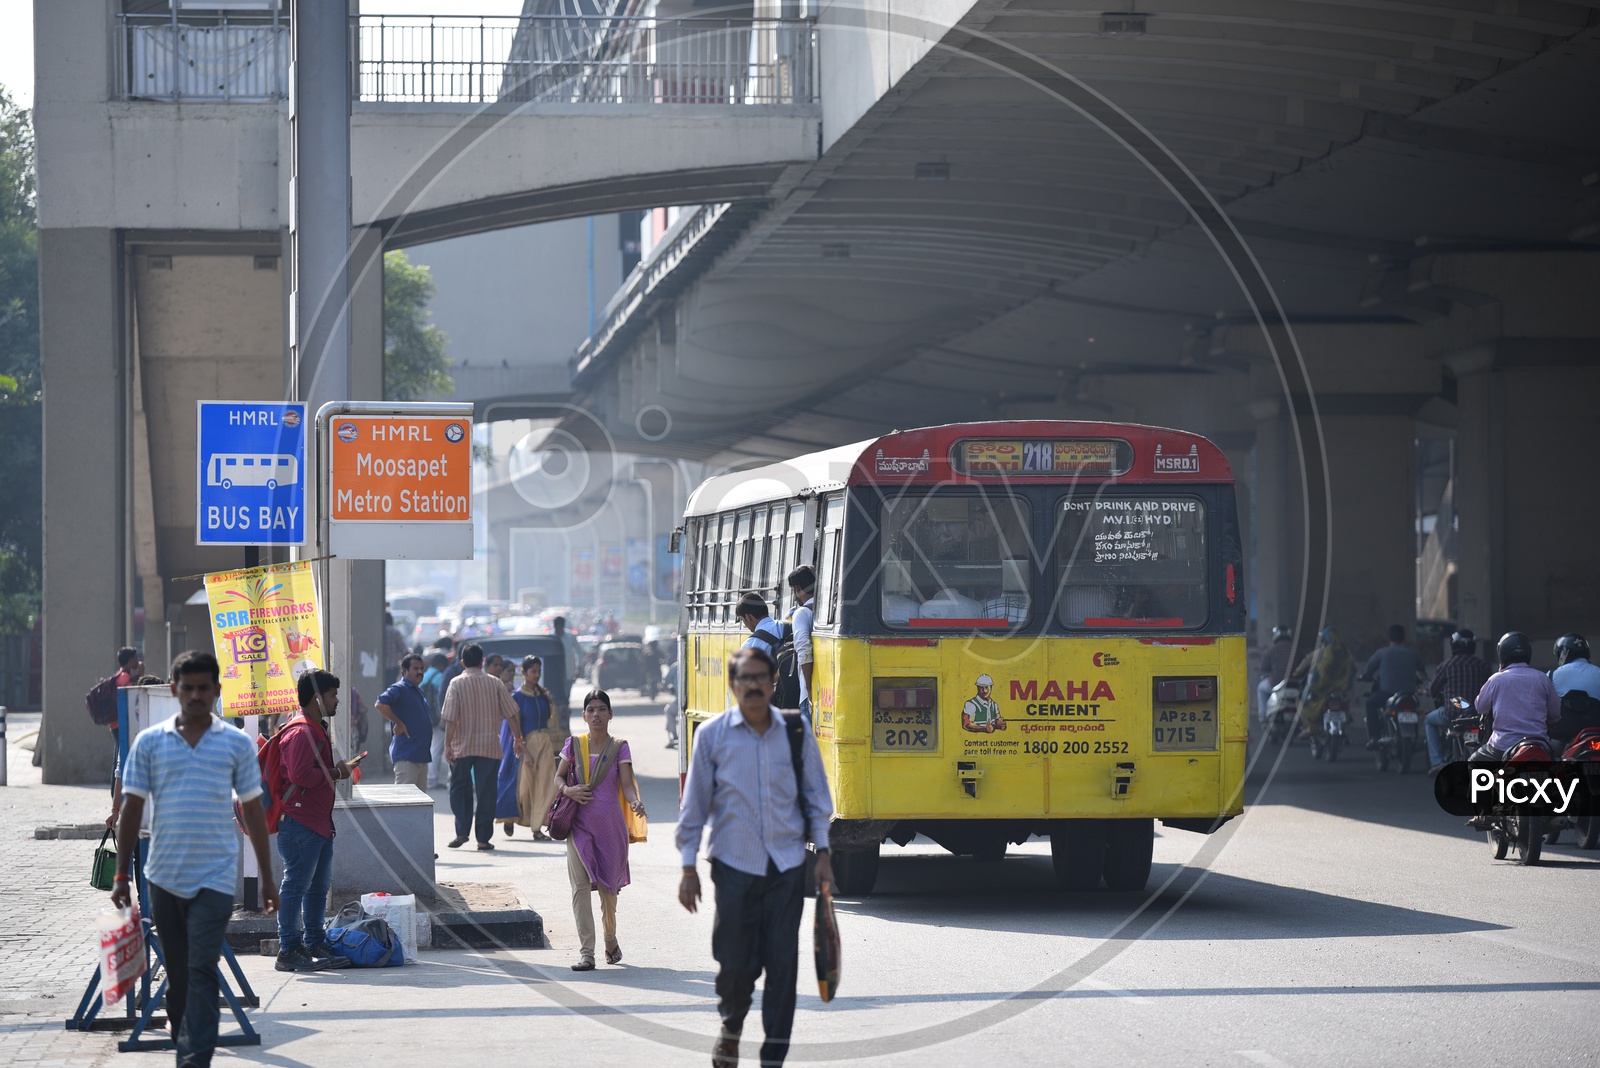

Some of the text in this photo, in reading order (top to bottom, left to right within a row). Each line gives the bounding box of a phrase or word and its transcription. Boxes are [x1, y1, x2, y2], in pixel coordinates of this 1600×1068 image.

[229, 410, 278, 426] HMRL
[372, 425, 433, 441] HMRL
[1023, 442, 1052, 470] 218
[356, 452, 448, 481] Moosapet
[1156, 459, 1197, 470] MSRD.1
[337, 489, 467, 513] Metro Station
[1063, 501, 1196, 512] DONT DRINK AND DRIVE
[208, 505, 299, 530] BUS BAY
[215, 602, 314, 629] SRR FIREWORKS
[235, 633, 266, 652] KG
[237, 691, 257, 700] NOW
[266, 687, 299, 697] MOOSAP
[1009, 679, 1116, 701] MAHA
[230, 700, 259, 709] BESIDE
[260, 696, 295, 706] ANDHRA
[1026, 703, 1100, 716] CEMENT
[237, 708, 265, 716] GOODS
[267, 705, 290, 714] SHED
[964, 739, 1019, 747] Contact customer
[1023, 741, 1129, 754] 1800 200 2552
[980, 747, 991, 755] toll
